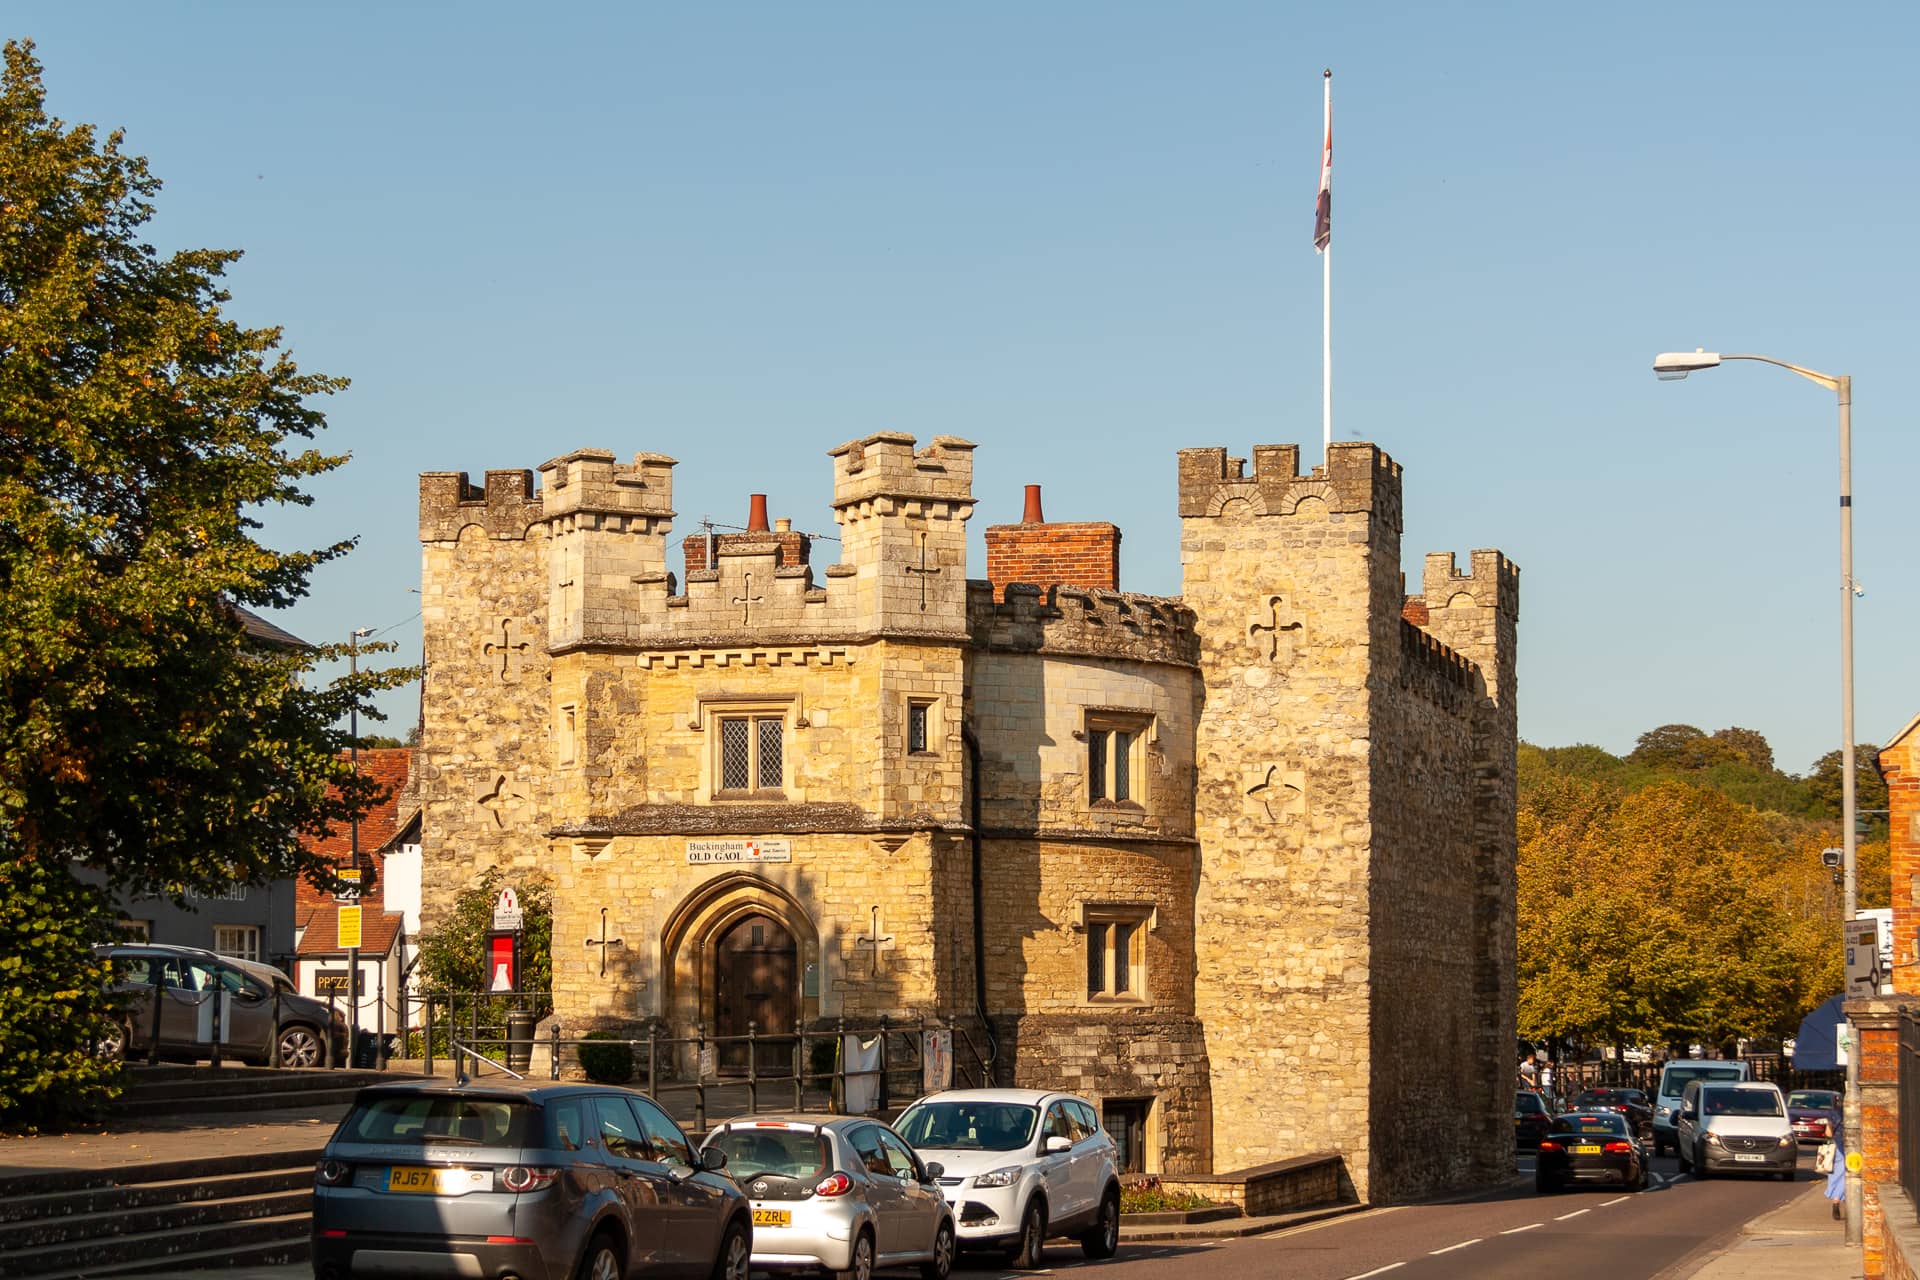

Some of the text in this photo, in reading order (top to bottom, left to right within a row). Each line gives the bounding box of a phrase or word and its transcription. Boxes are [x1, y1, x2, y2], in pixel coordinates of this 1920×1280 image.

[689, 842, 743, 852] Buckingham
[689, 852, 711, 861] OLD
[715, 852, 743, 861] GAOL
[318, 976, 361, 989] PRZZ
[392, 1171, 428, 1186] RJ67
[765, 1211, 785, 1222] ZRL
